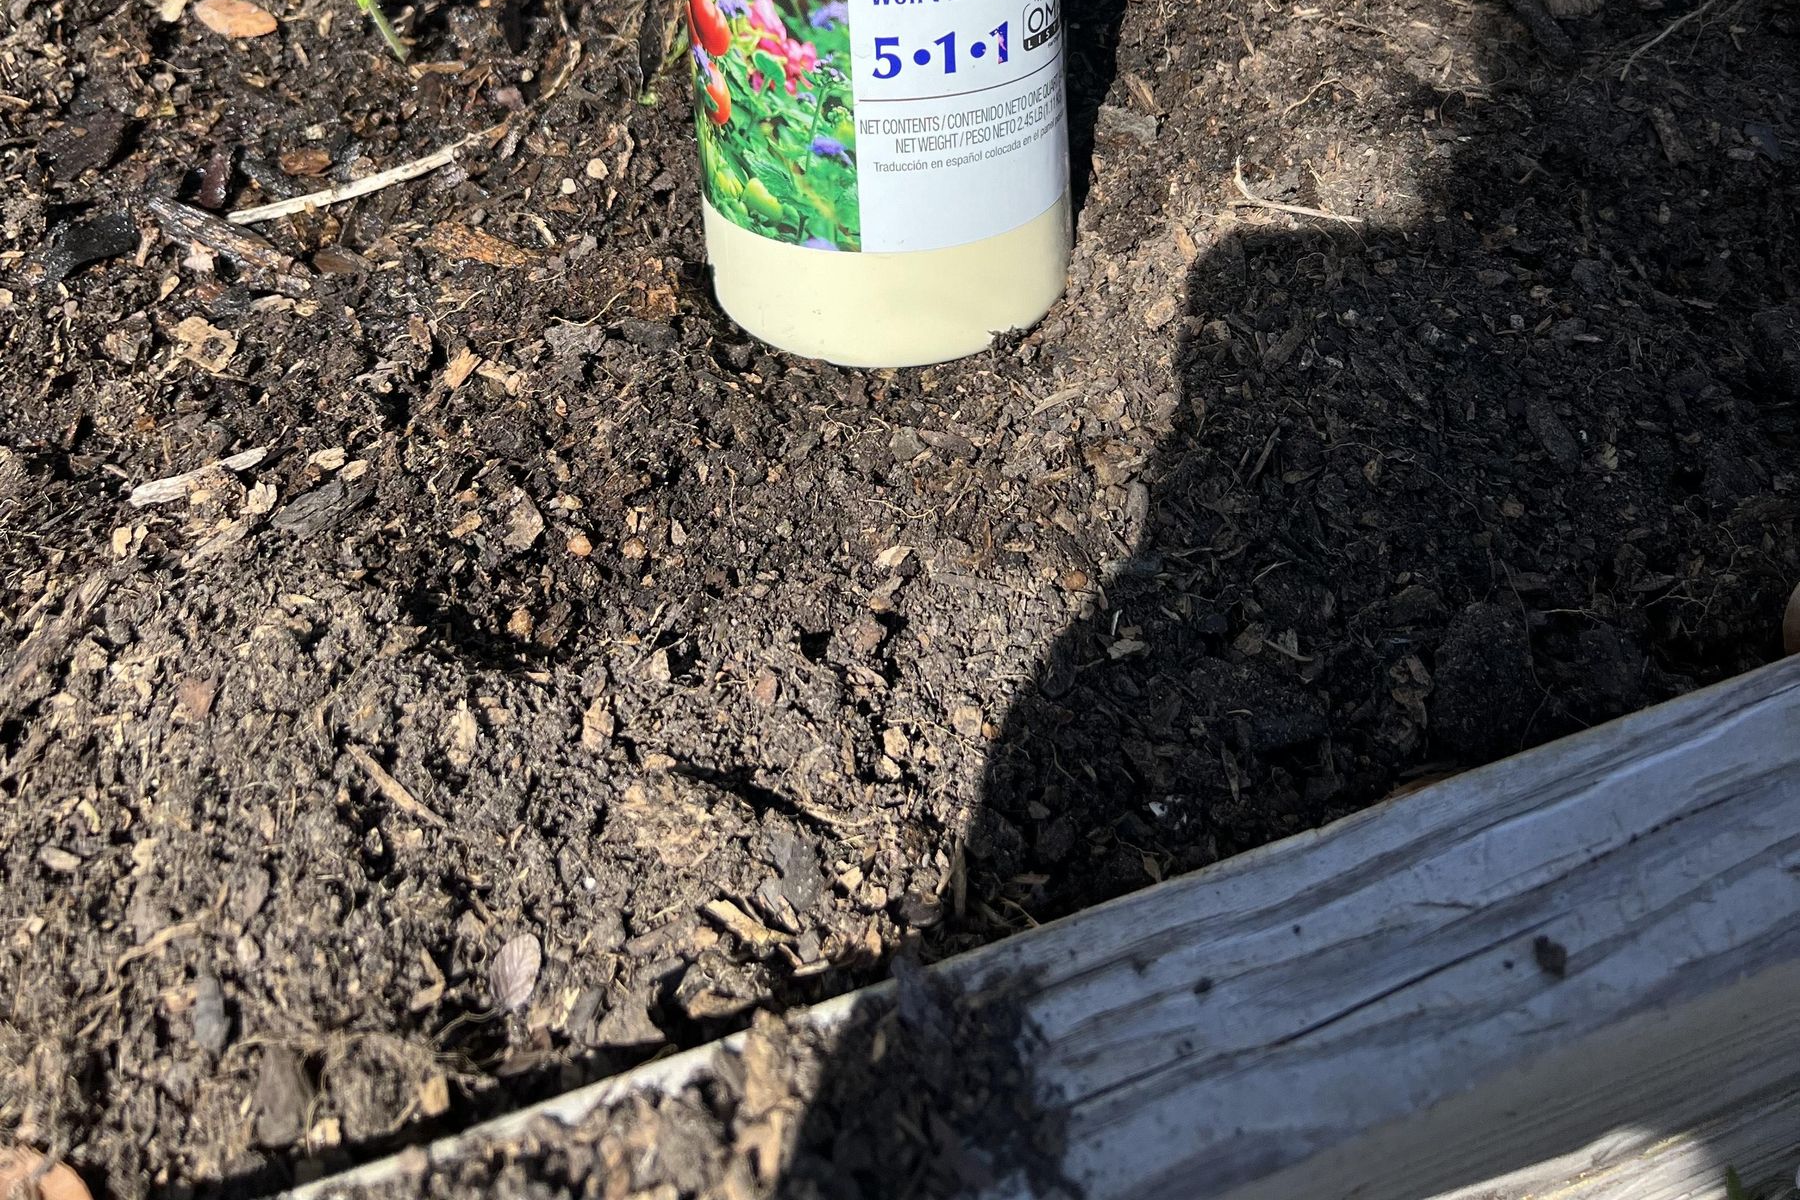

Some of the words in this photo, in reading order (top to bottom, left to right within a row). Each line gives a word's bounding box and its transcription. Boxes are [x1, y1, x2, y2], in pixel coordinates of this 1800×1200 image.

[860, 119, 880, 135] NET
[882, 116, 939, 135] CONTENTS
[947, 104, 1003, 129] CONTENIDO
[1005, 95, 1026, 117] NETO
[1028, 86, 1042, 107] ONE
[895, 138, 915, 154] NET
[918, 133, 958, 152] WEIGHT
[966, 127, 991, 145] PESO
[993, 119, 1016, 139] NETO
[1017, 111, 1033, 131] 2.45
[1034, 106, 1042, 122] LB
[873, 160, 928, 172] Traducción
[931, 160, 943, 169] en
[946, 150, 982, 167] español
[985, 140, 1021, 159] colocada
[1023, 136, 1032, 146] en
[1033, 130, 1039, 140] el
